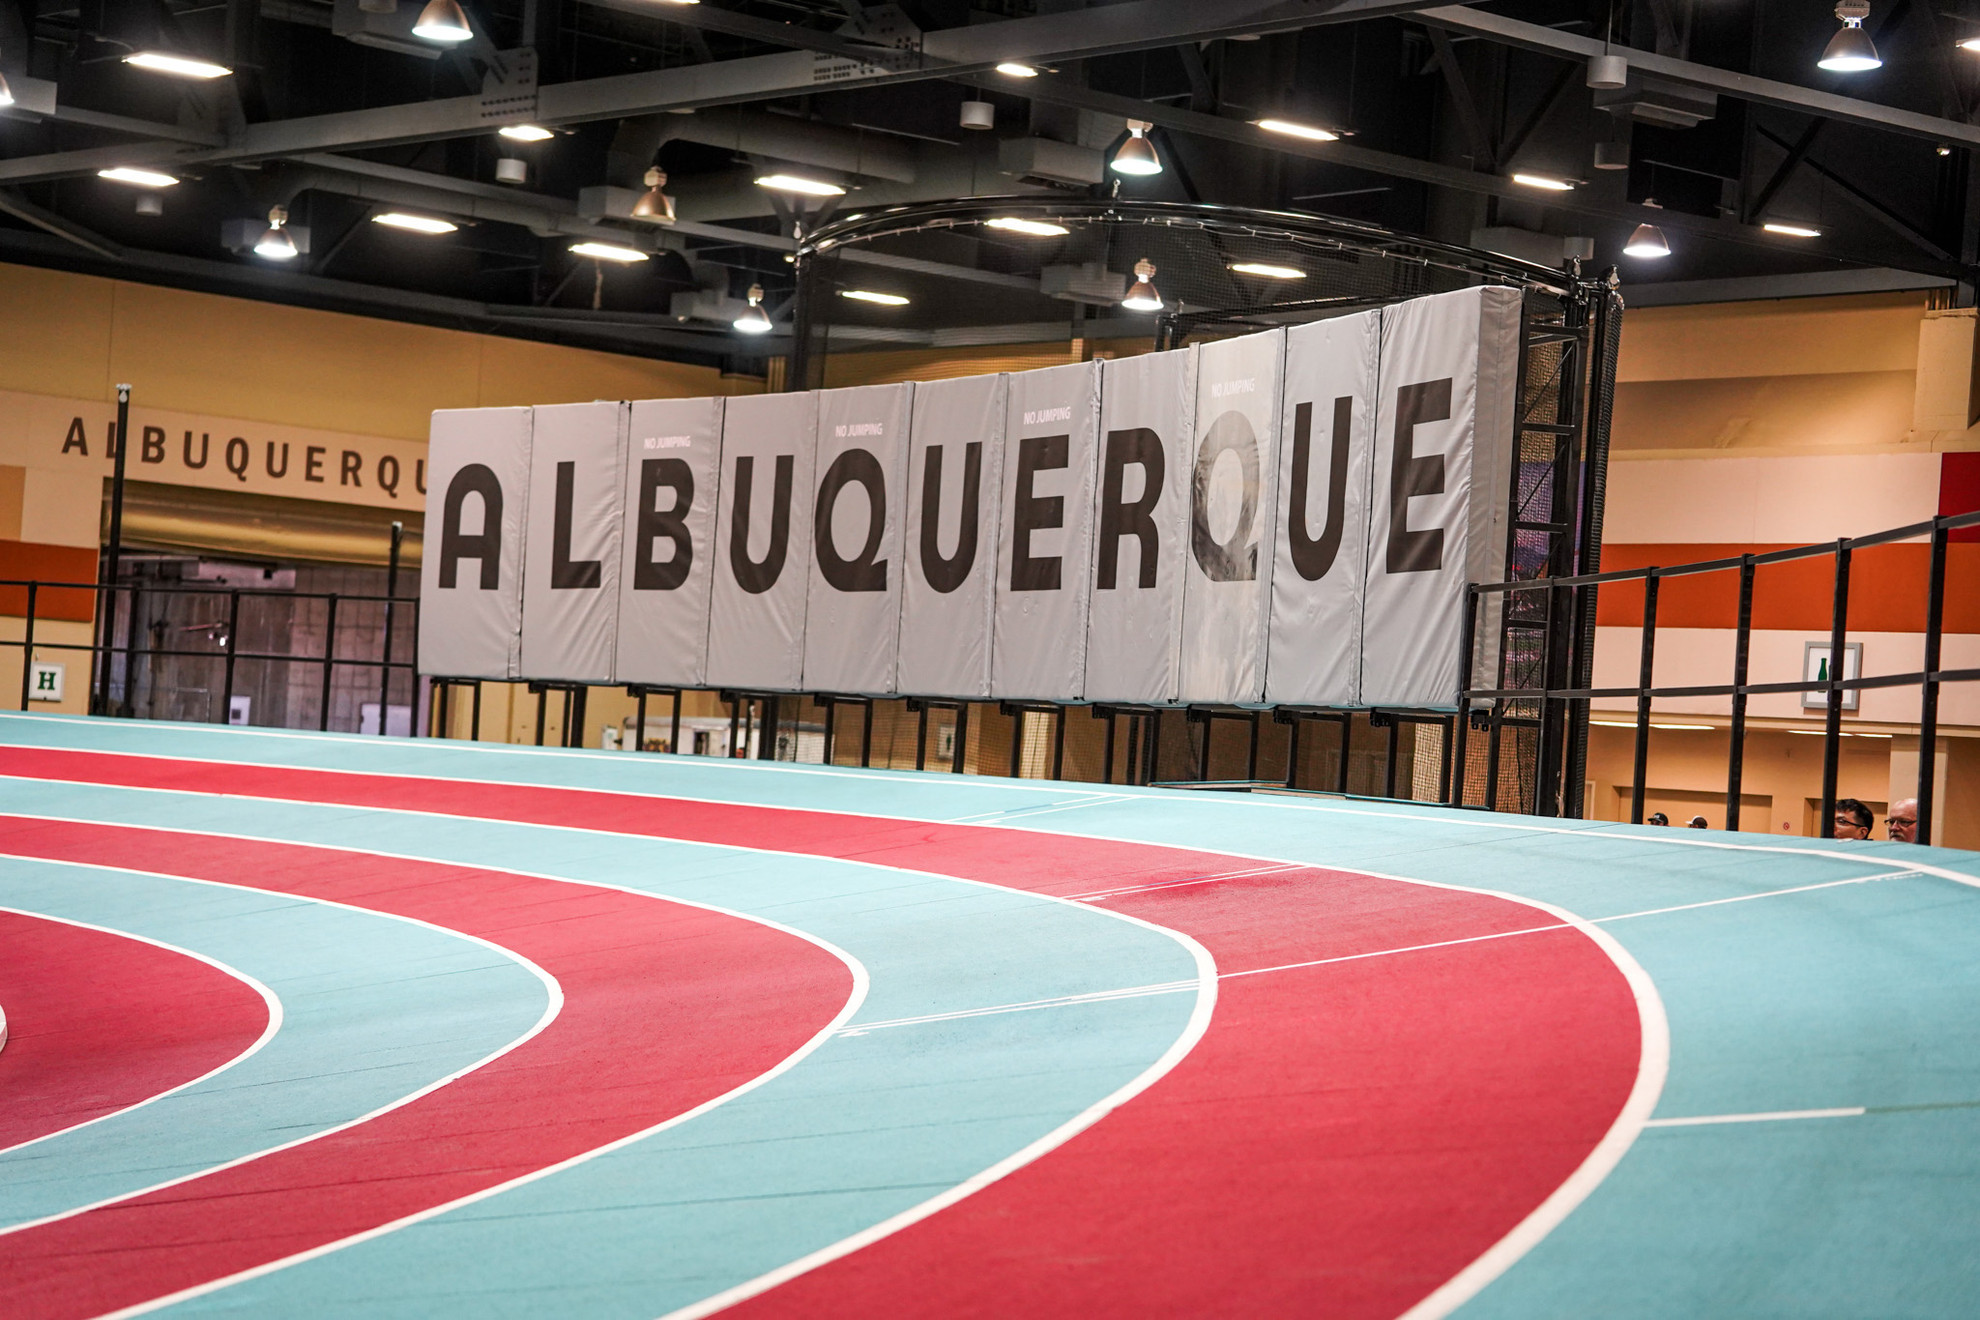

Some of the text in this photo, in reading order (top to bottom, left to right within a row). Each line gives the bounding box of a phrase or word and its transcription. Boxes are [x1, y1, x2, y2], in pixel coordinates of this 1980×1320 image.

[1024, 406, 1071, 424] NO JUMPING
[835, 422, 883, 437] NO JUMPING
[644, 435, 691, 449] NO JUMPING
[438, 378, 1452, 594] ALBUQUERQUE
[37, 671, 57, 690] H
